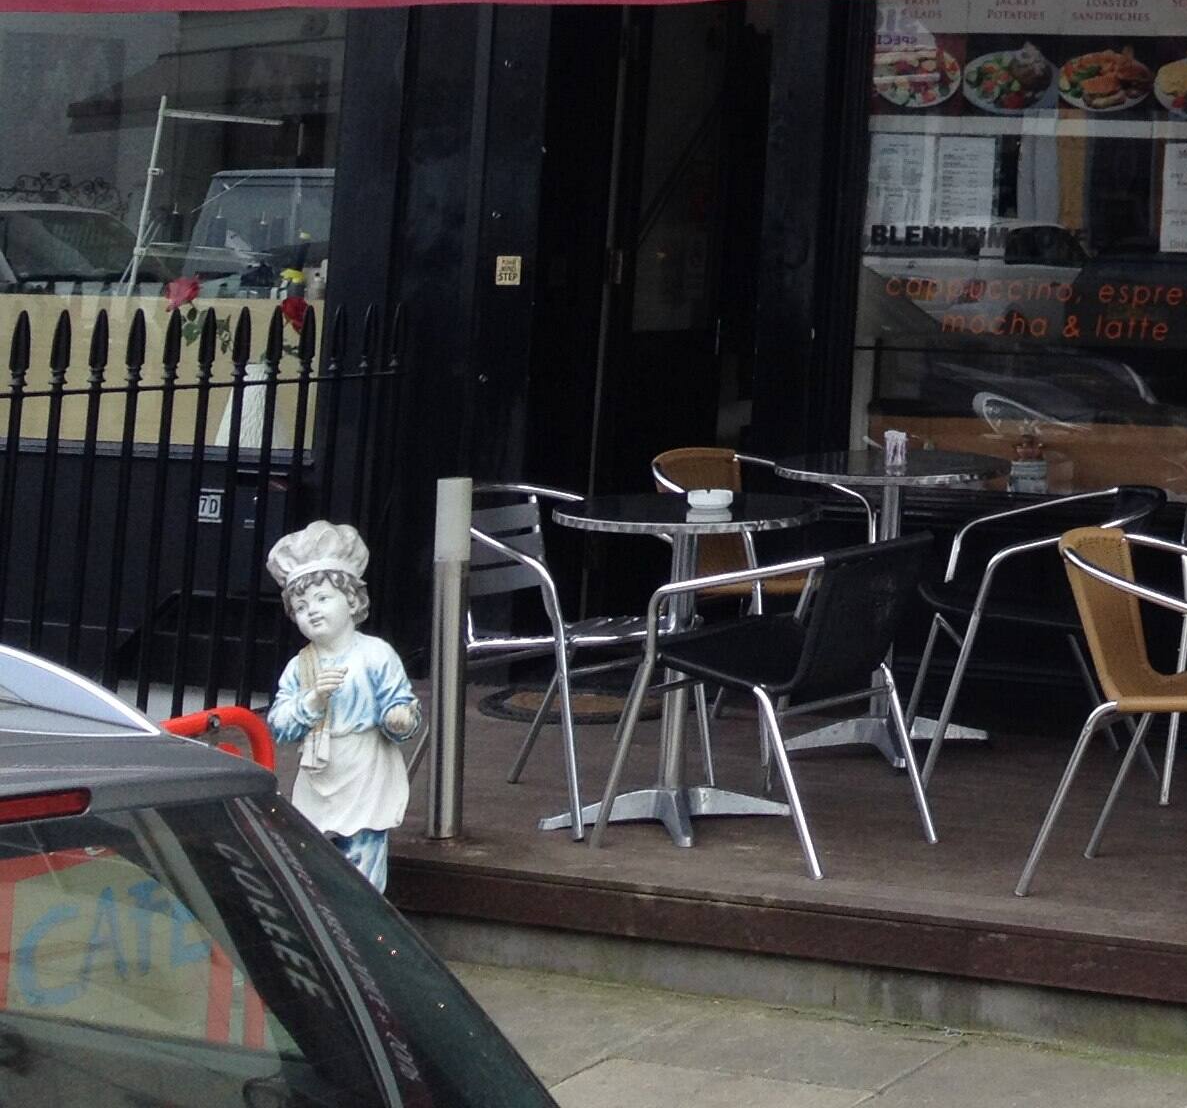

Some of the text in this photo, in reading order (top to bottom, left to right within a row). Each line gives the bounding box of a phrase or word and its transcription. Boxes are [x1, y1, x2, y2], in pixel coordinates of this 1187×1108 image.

[941, 309, 1169, 342] mocha & latte
